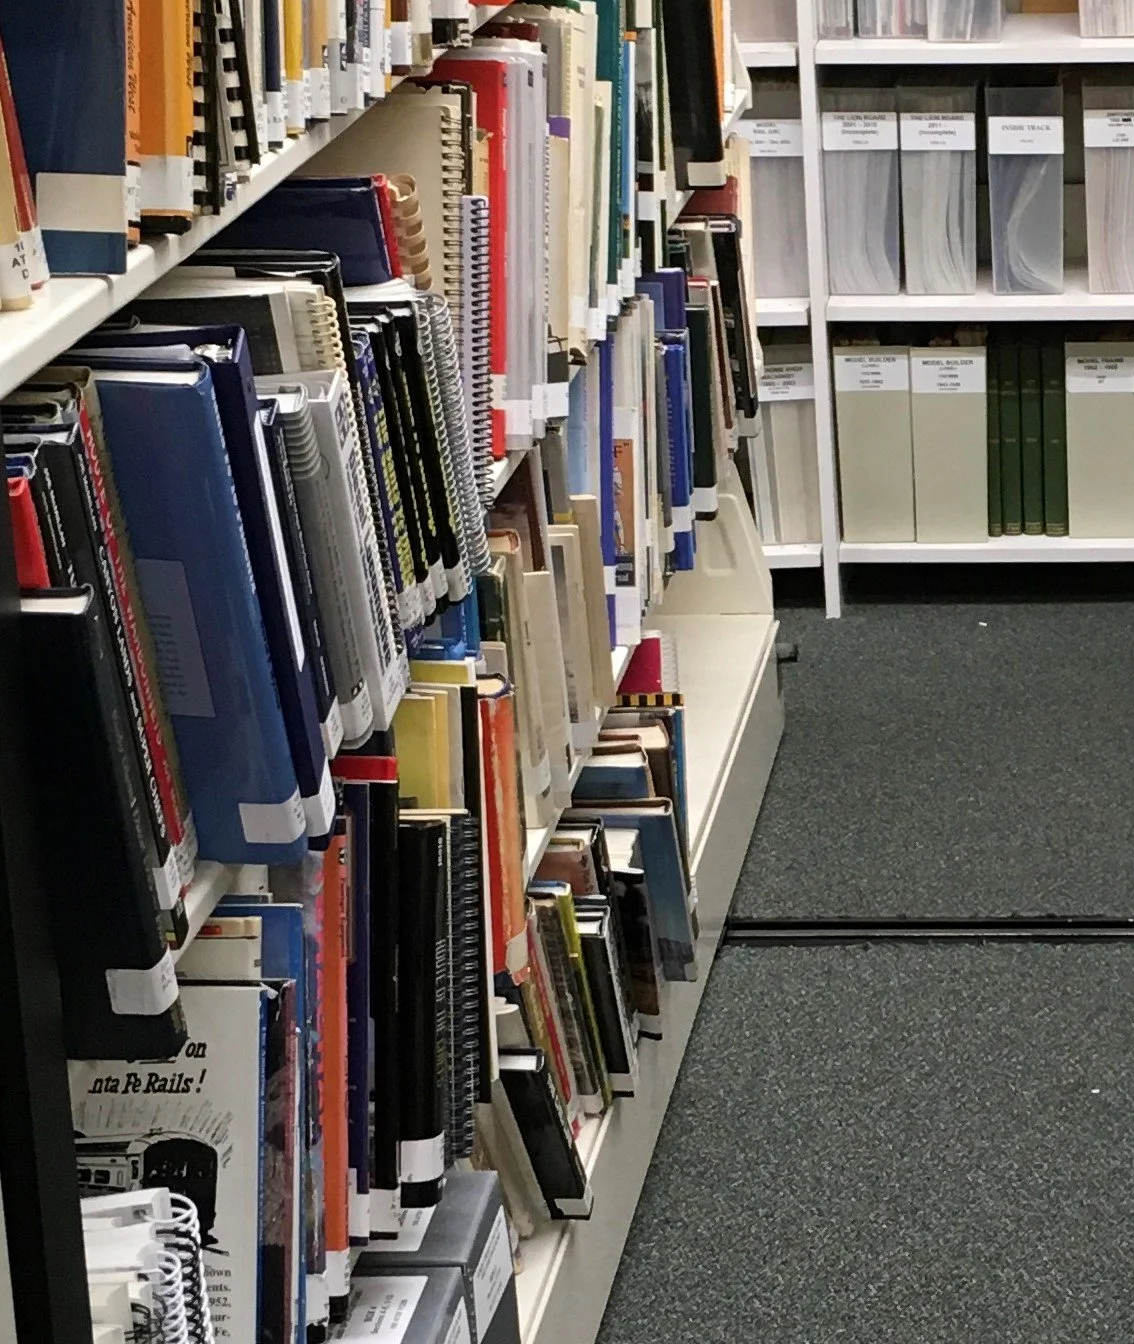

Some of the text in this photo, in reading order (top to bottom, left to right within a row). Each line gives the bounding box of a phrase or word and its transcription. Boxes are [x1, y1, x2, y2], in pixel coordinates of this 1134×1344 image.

[98, 545, 120, 625] CANYON
[115, 627, 134, 687] LANDS
[122, 1072, 141, 1093] Fe
